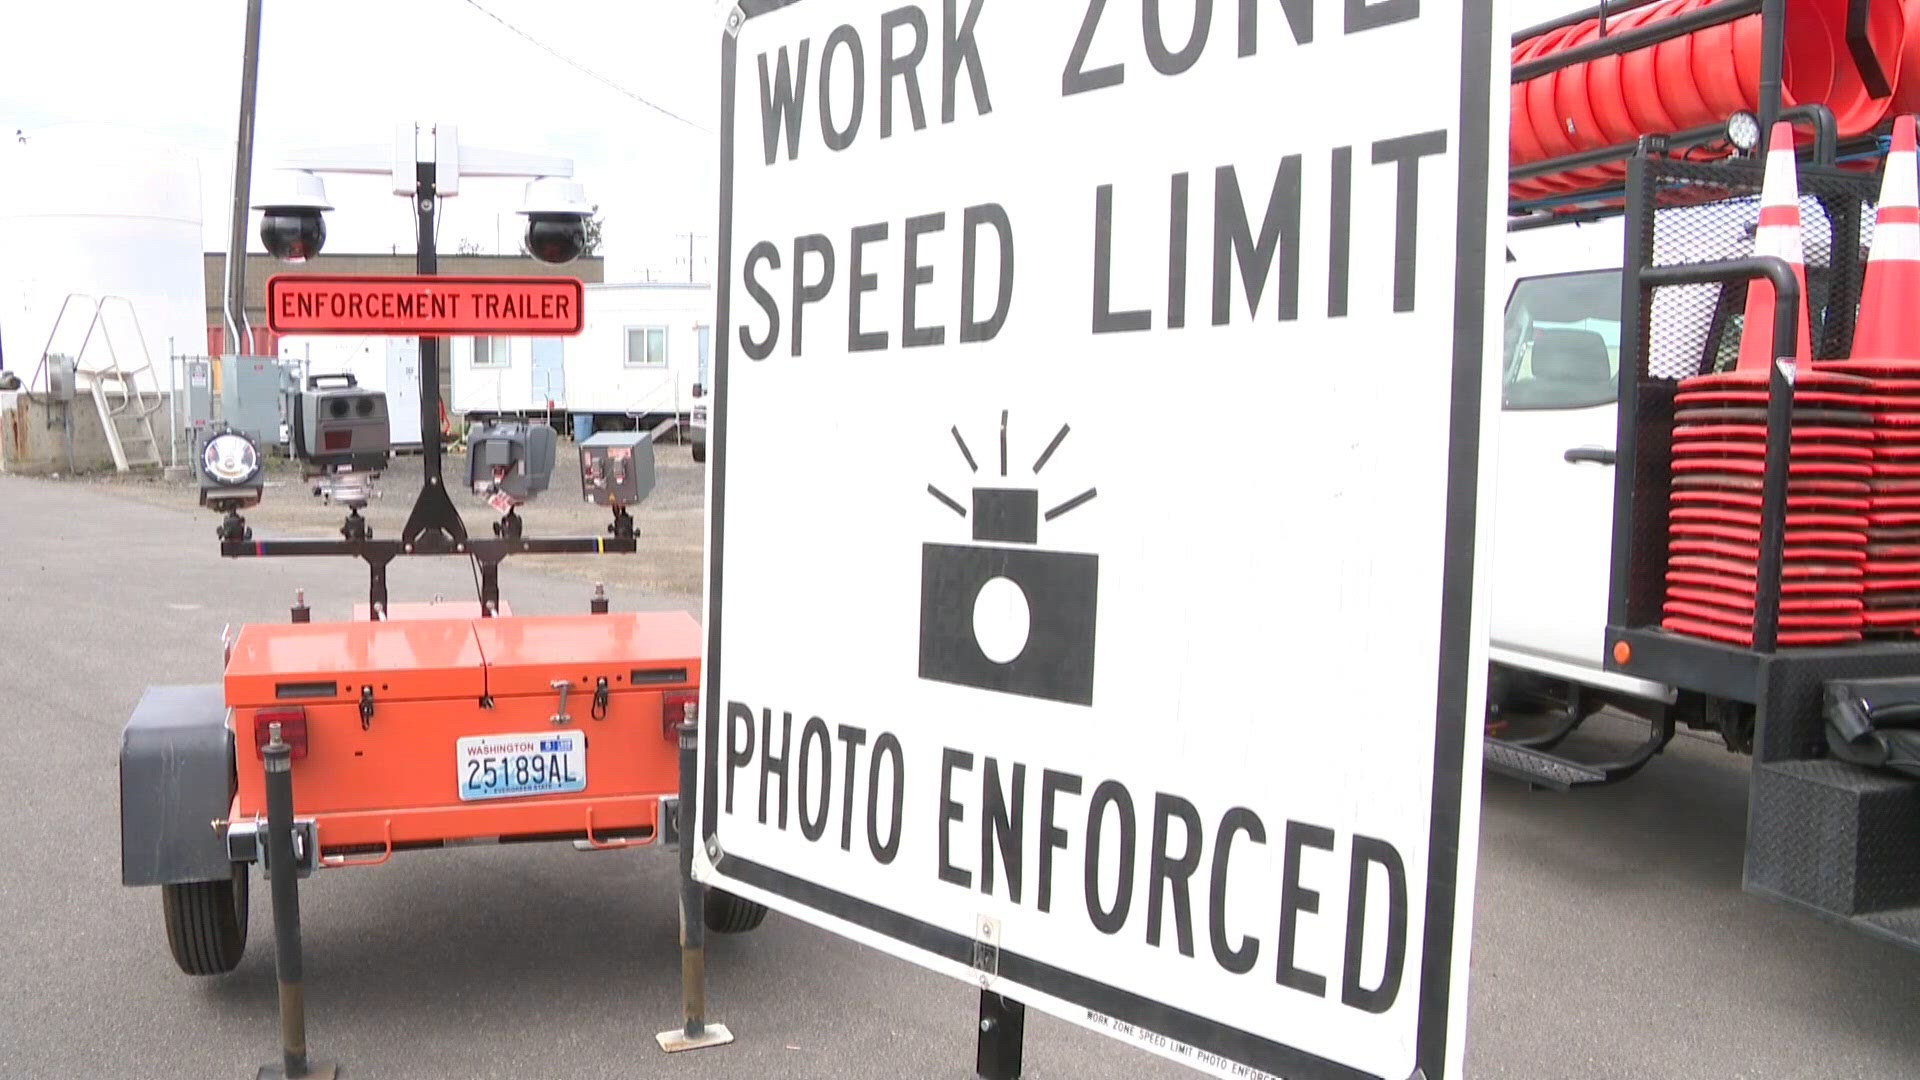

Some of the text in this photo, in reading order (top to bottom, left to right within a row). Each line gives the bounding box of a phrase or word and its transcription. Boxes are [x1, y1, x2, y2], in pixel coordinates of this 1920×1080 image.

[758, 0, 1420, 166] WORK ZO
[739, 130, 1447, 361] SPEED LIMIT
[281, 292, 570, 319] ENFORCEMENT TRAILER
[467, 743, 535, 756] WASHINGTON
[468, 753, 577, 790] 25189AL
[494, 785, 533, 794] EVERGREEN
[725, 701, 1408, 1015] PHOTO ENFORCED
[1086, 1011, 1109, 1026] WORK
[1113, 1020, 1135, 1036] ZONE
[1139, 1029, 1166, 1048] SPEED
[1170, 1040, 1194, 1058] LIMIT
[1197, 1051, 1227, 1070] PHOTO
